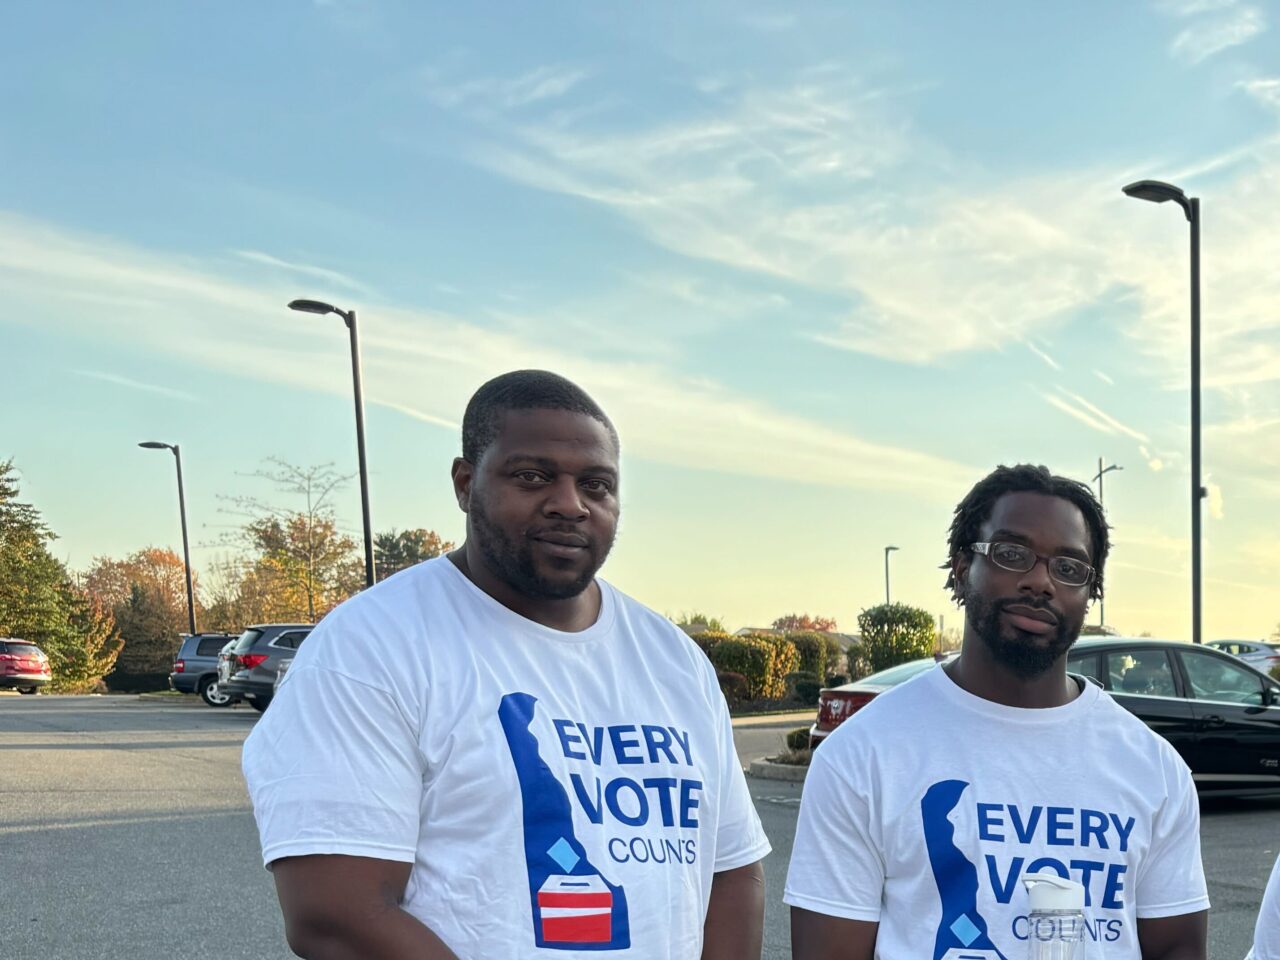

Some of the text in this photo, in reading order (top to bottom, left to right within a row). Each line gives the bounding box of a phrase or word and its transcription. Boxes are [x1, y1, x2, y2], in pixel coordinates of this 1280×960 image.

[552, 719, 694, 766] EVERY
[570, 773, 703, 828] VOTE
[608, 837, 697, 864] COUNS
[976, 802, 1136, 852] EVERY
